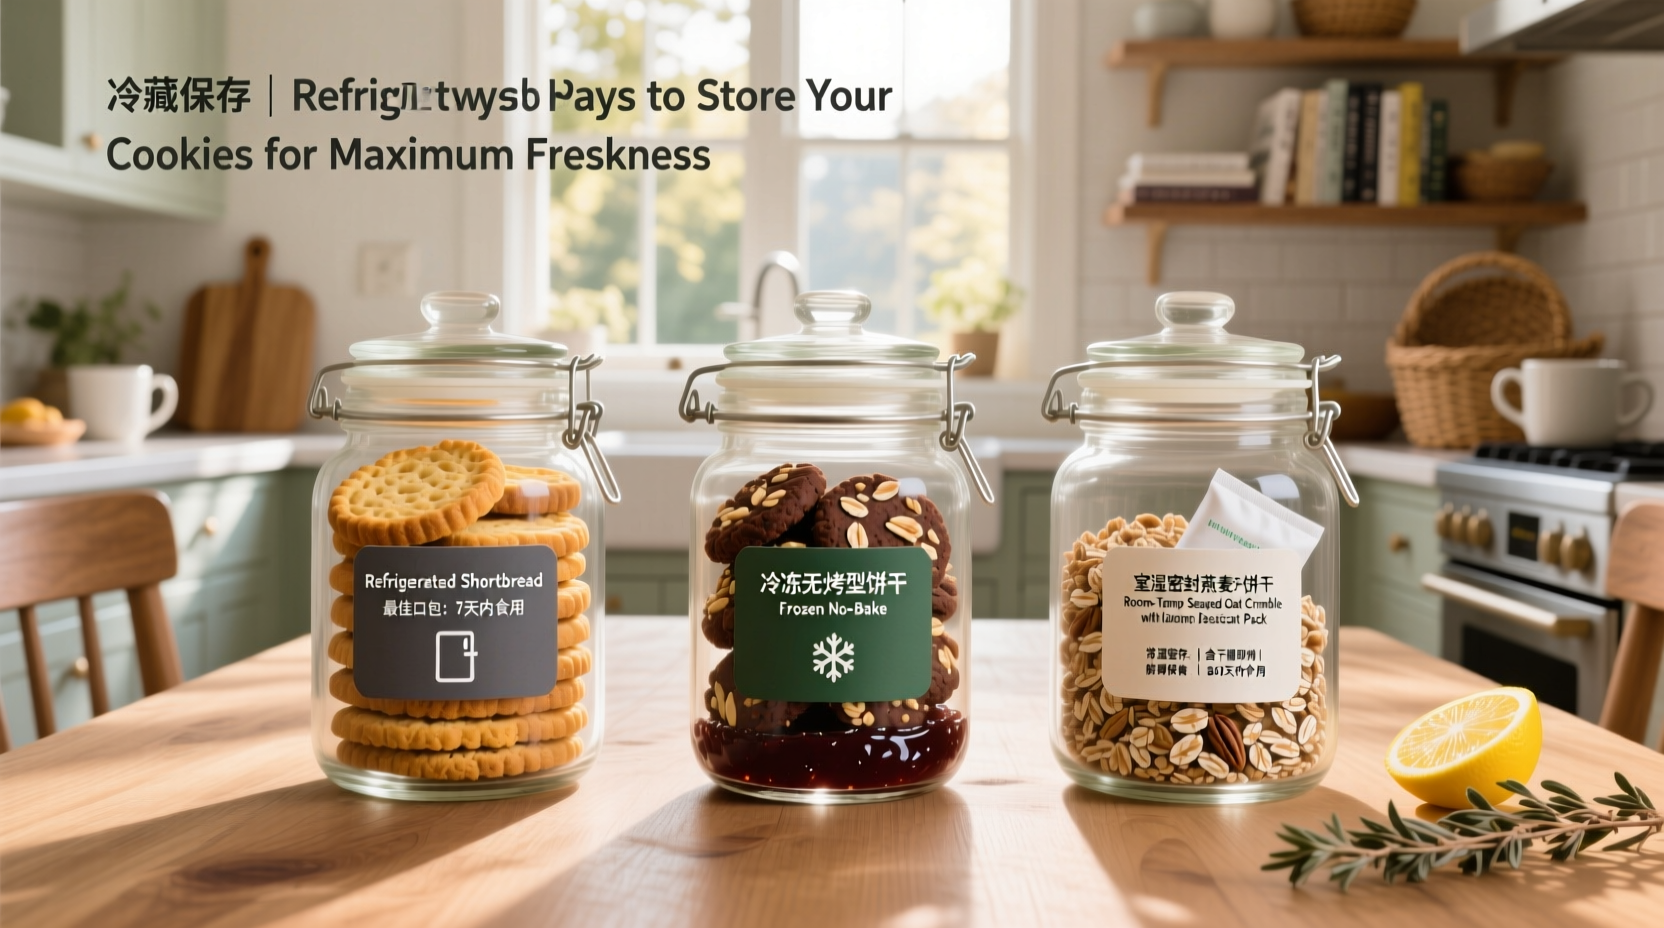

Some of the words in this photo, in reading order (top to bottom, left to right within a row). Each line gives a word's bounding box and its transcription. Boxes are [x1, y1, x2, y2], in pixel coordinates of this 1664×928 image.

[365, 572, 456, 593] Refrigerated
[461, 571, 543, 589] Shortbread
[760, 570, 908, 596] 冷冻无烤型饼干
[779, 601, 825, 616] Frozen
[828, 600, 888, 616] No-Bake
